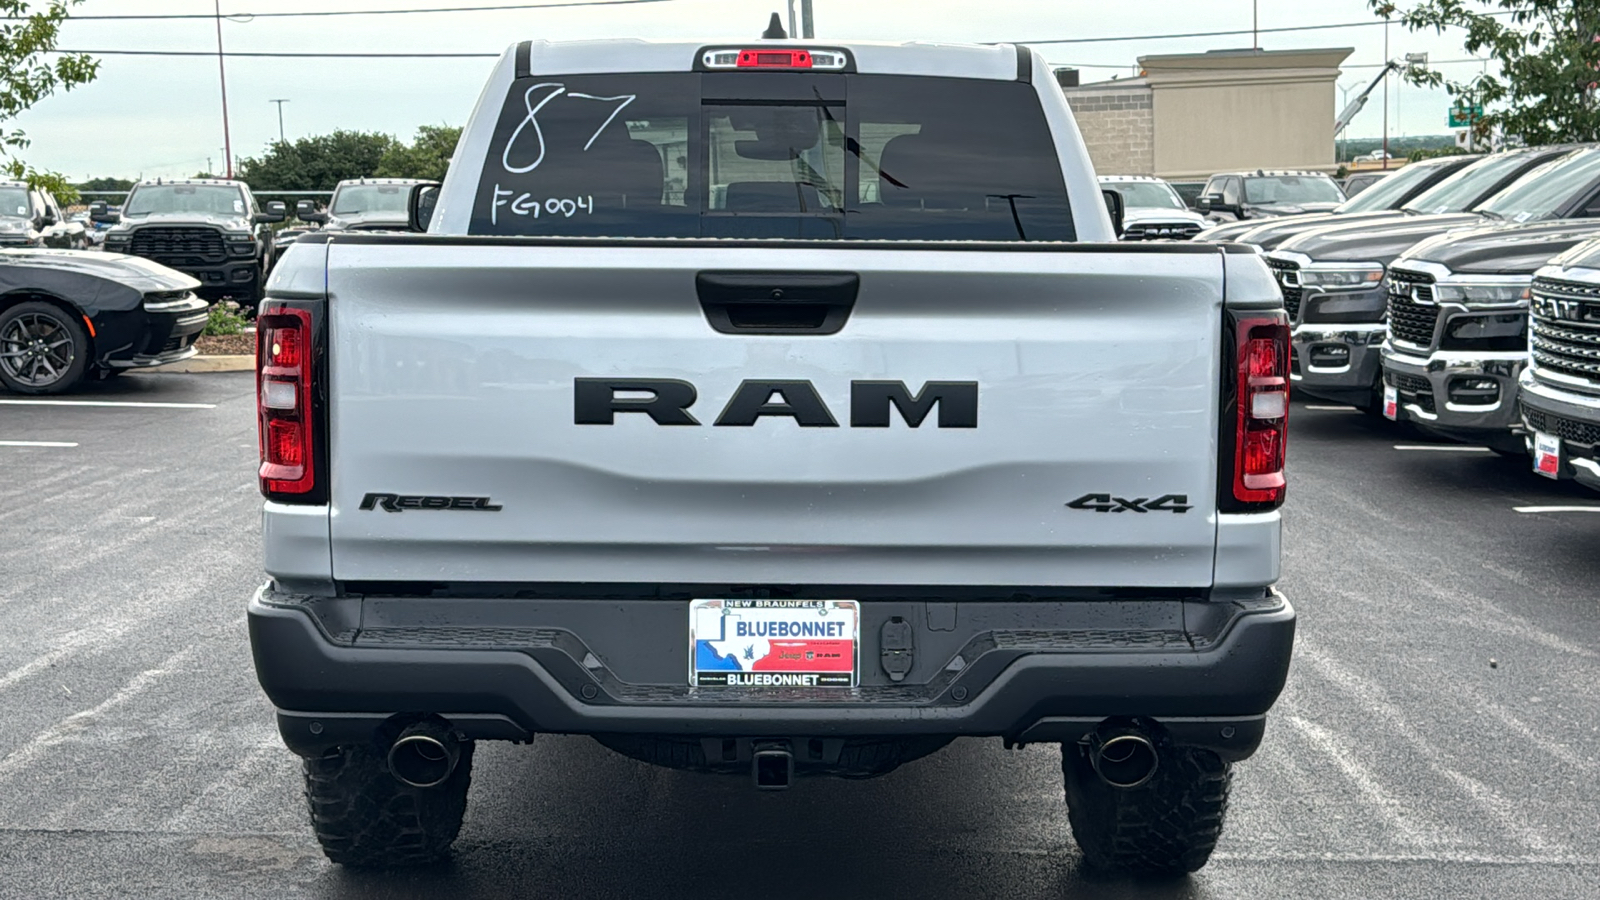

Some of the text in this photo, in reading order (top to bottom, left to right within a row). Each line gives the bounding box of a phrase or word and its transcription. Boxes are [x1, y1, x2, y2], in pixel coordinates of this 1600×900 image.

[502, 82, 636, 174] 87
[574, 377, 978, 428] RAM
[359, 493, 503, 512] REBEL
[1064, 493, 1194, 513] 4x4
[726, 600, 824, 608] NEW BRAUNFELS
[736, 621, 845, 637] BLUEBONNET
[727, 674, 819, 685] BLUEBONNET
